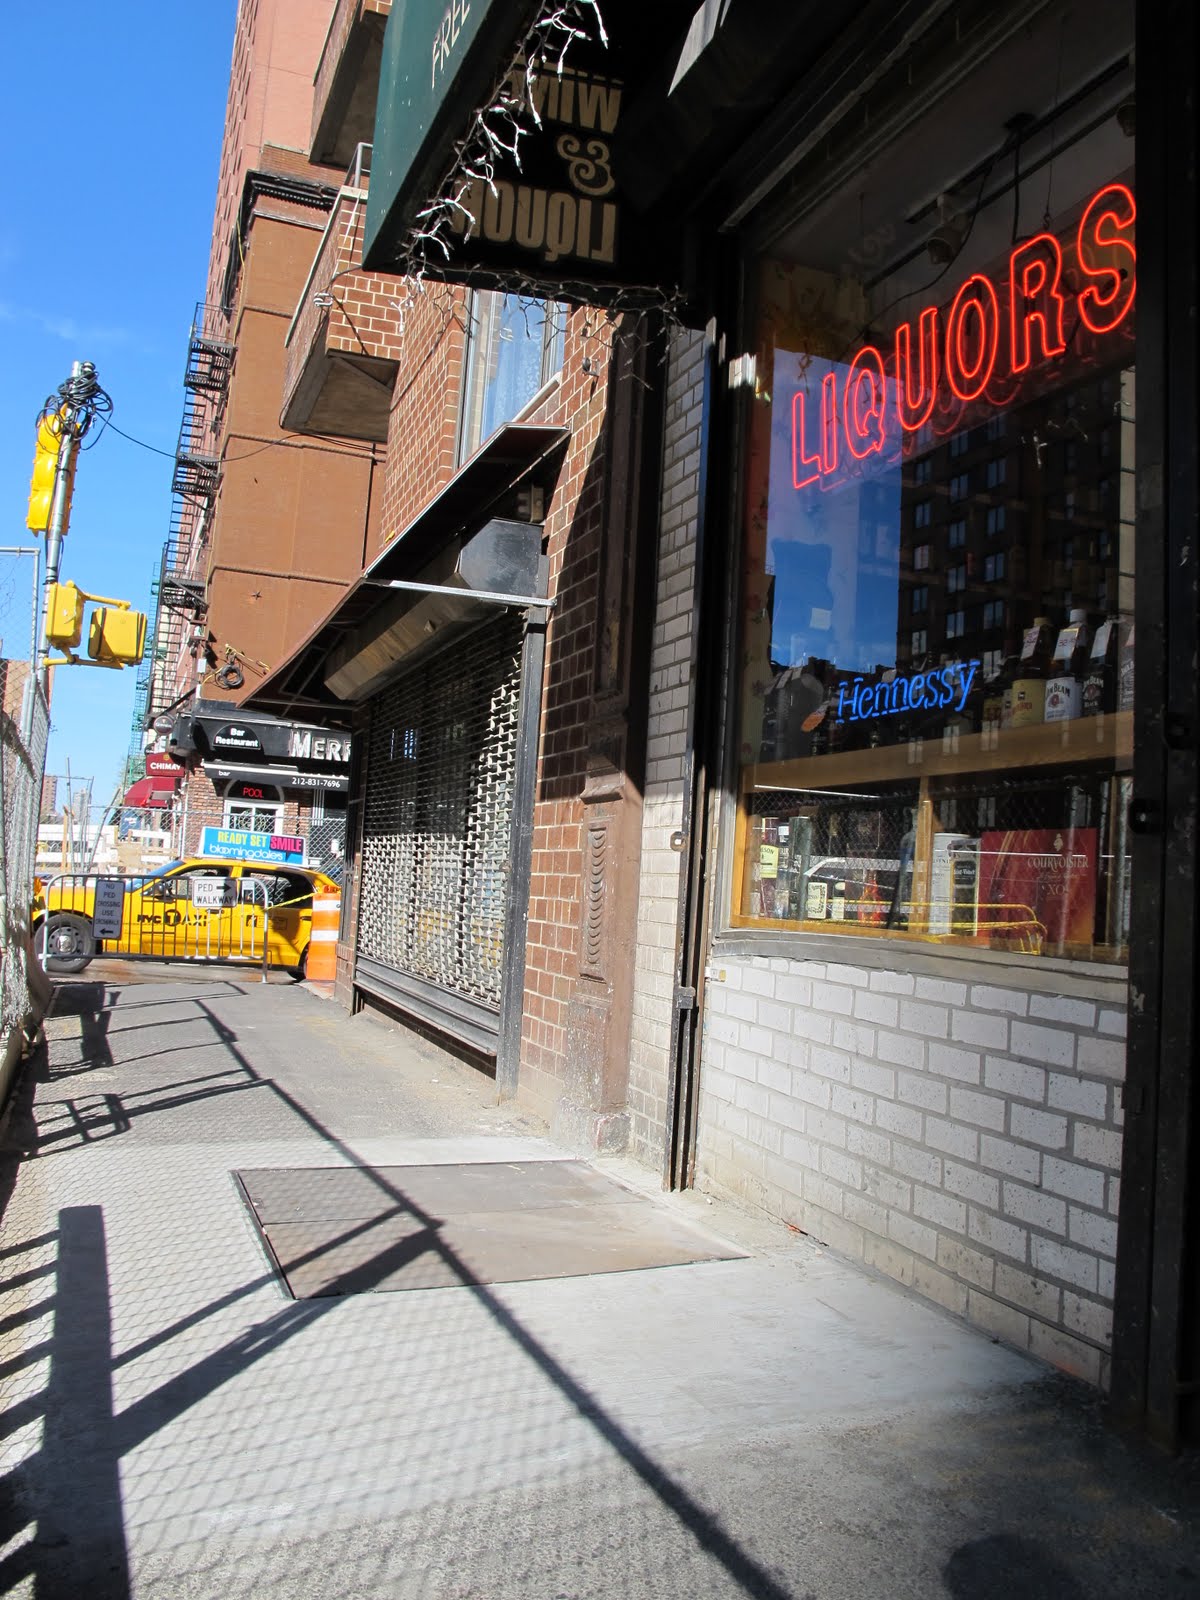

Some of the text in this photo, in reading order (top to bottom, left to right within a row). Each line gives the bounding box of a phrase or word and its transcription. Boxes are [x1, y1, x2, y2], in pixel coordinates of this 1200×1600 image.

[792, 183, 1137, 490] LIQUORS
[836, 659, 981, 724] Hennessy
[230, 728, 245, 737] Bar
[215, 736, 259, 748] Restaurant
[150, 762, 181, 771] CHIMAY
[291, 777, 341, 788] 212-831-7696
[242, 787, 263, 798] POOL
[218, 831, 302, 852] READY SET SMILE
[1027, 856, 1089, 872] COURVOISIER
[197, 883, 213, 892] PED
[196, 895, 233, 904] WALKWAY
[137, 914, 162, 924] NYC
